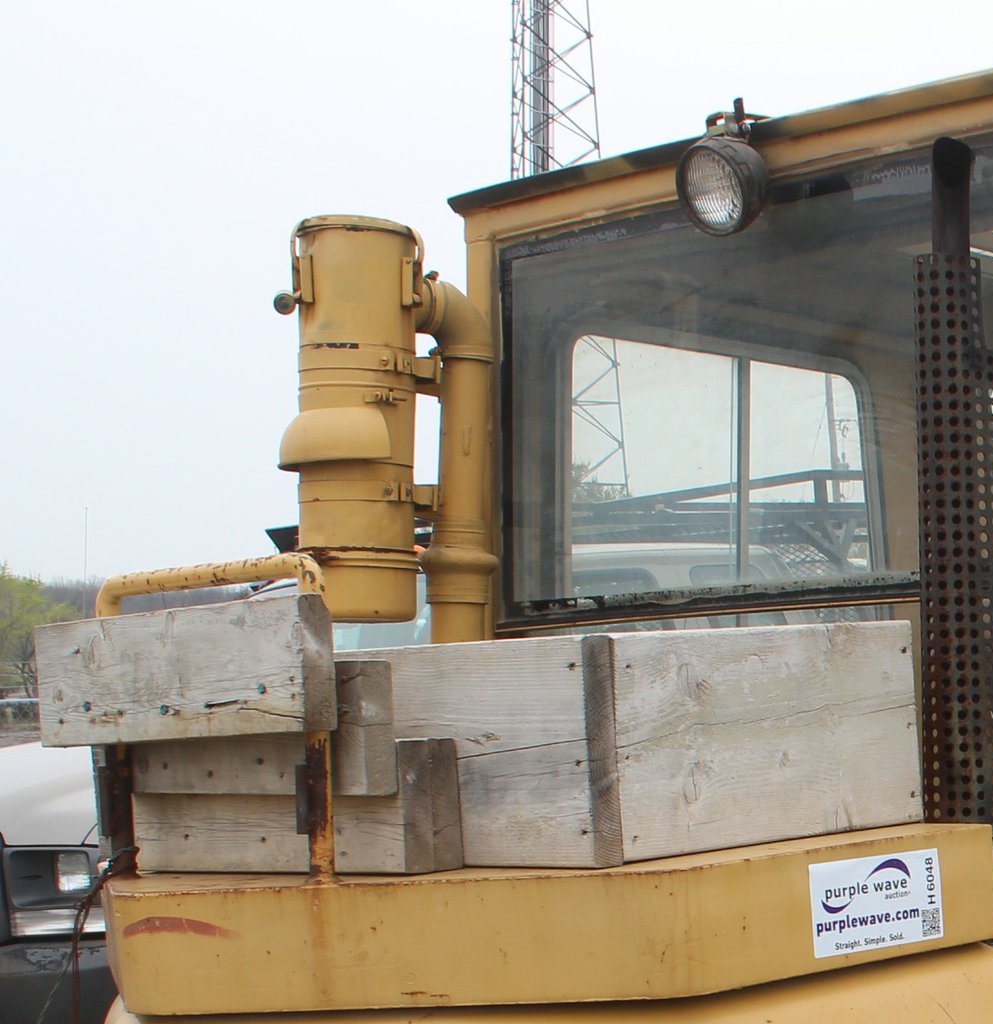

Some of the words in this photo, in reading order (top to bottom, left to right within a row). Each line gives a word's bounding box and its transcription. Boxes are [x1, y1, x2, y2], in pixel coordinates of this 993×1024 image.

[825, 881, 869, 902] purple
[873, 878, 908, 892] wave
[816, 907, 920, 937] purplewave.com
[835, 938, 863, 951] Straight.
[864, 935, 888, 946] Simple.
[889, 931, 905, 942] Sold.
